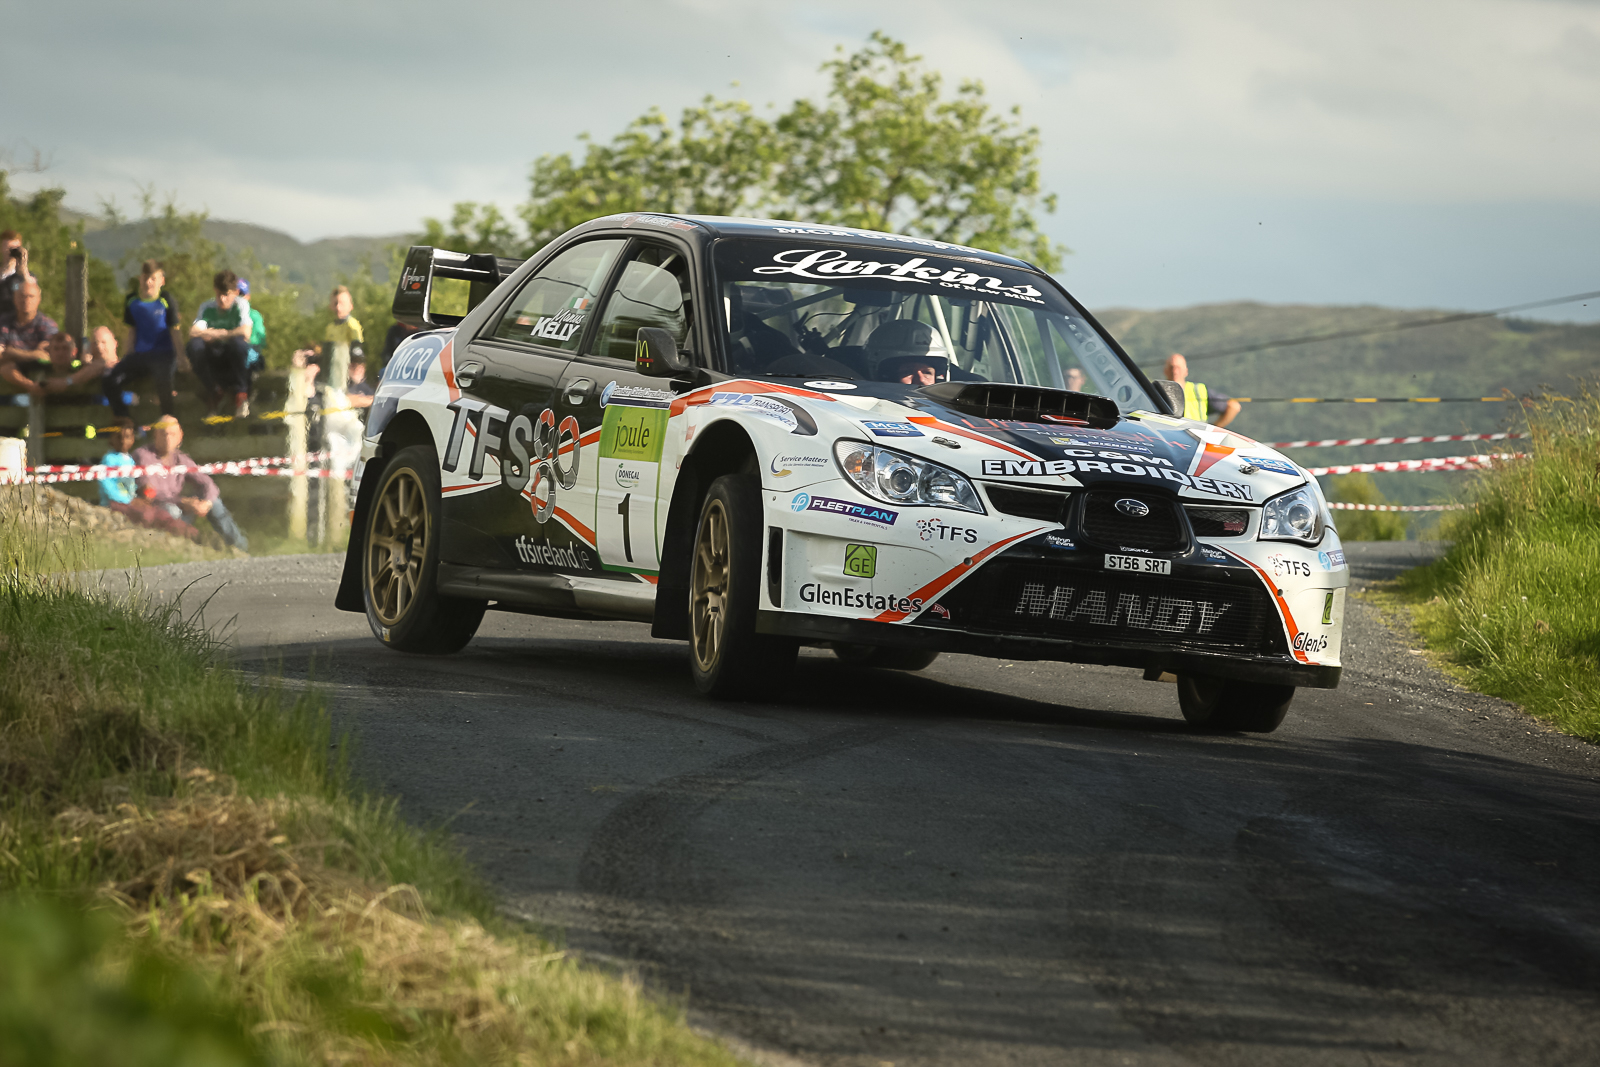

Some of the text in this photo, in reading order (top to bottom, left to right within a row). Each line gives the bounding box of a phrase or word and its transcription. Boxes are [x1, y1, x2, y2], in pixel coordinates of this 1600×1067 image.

[753, 249, 1043, 297] Larkins
[530, 316, 580, 342] KELLY
[389, 347, 434, 380] MCR
[751, 399, 795, 415] TRANSPORT
[612, 417, 650, 454] joule
[870, 421, 911, 431] MCR
[442, 397, 533, 491] TFS
[1087, 440, 1152, 453] MICHELIN
[779, 455, 829, 464] Service Matters
[1063, 449, 1174, 467] C&M
[618, 469, 640, 480] DONEGAL
[982, 459, 1254, 501] EMBROIDERY
[812, 499, 894, 522] FLEETPLAN
[617, 493, 634, 563] 1
[936, 525, 978, 544] TFS
[515, 535, 594, 571] tfsireland.ie
[1109, 555, 1168, 574] ST56 SRT
[849, 557, 870, 574] GE
[1282, 559, 1311, 577] TFS
[799, 583, 923, 613] GlenEstates
[1015, 582, 1233, 634] MANDY
